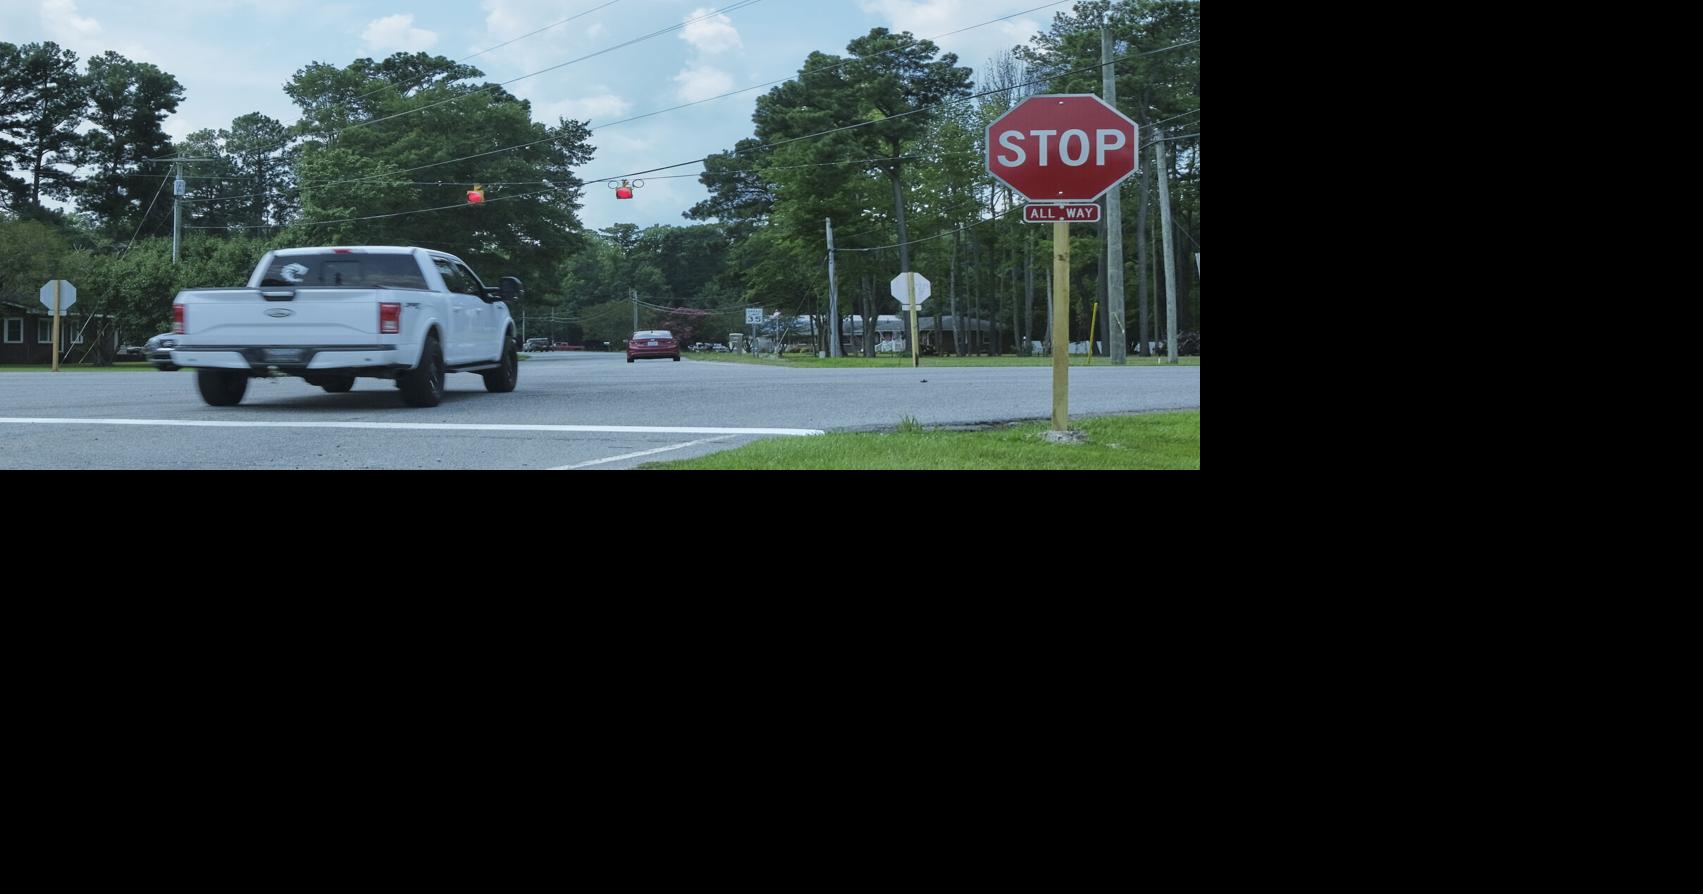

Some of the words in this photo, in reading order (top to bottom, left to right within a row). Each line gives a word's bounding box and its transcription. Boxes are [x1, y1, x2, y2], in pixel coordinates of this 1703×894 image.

[997, 128, 1126, 167] STOP
[1030, 208, 1055, 218] ALL
[1066, 208, 1093, 218] WAY
